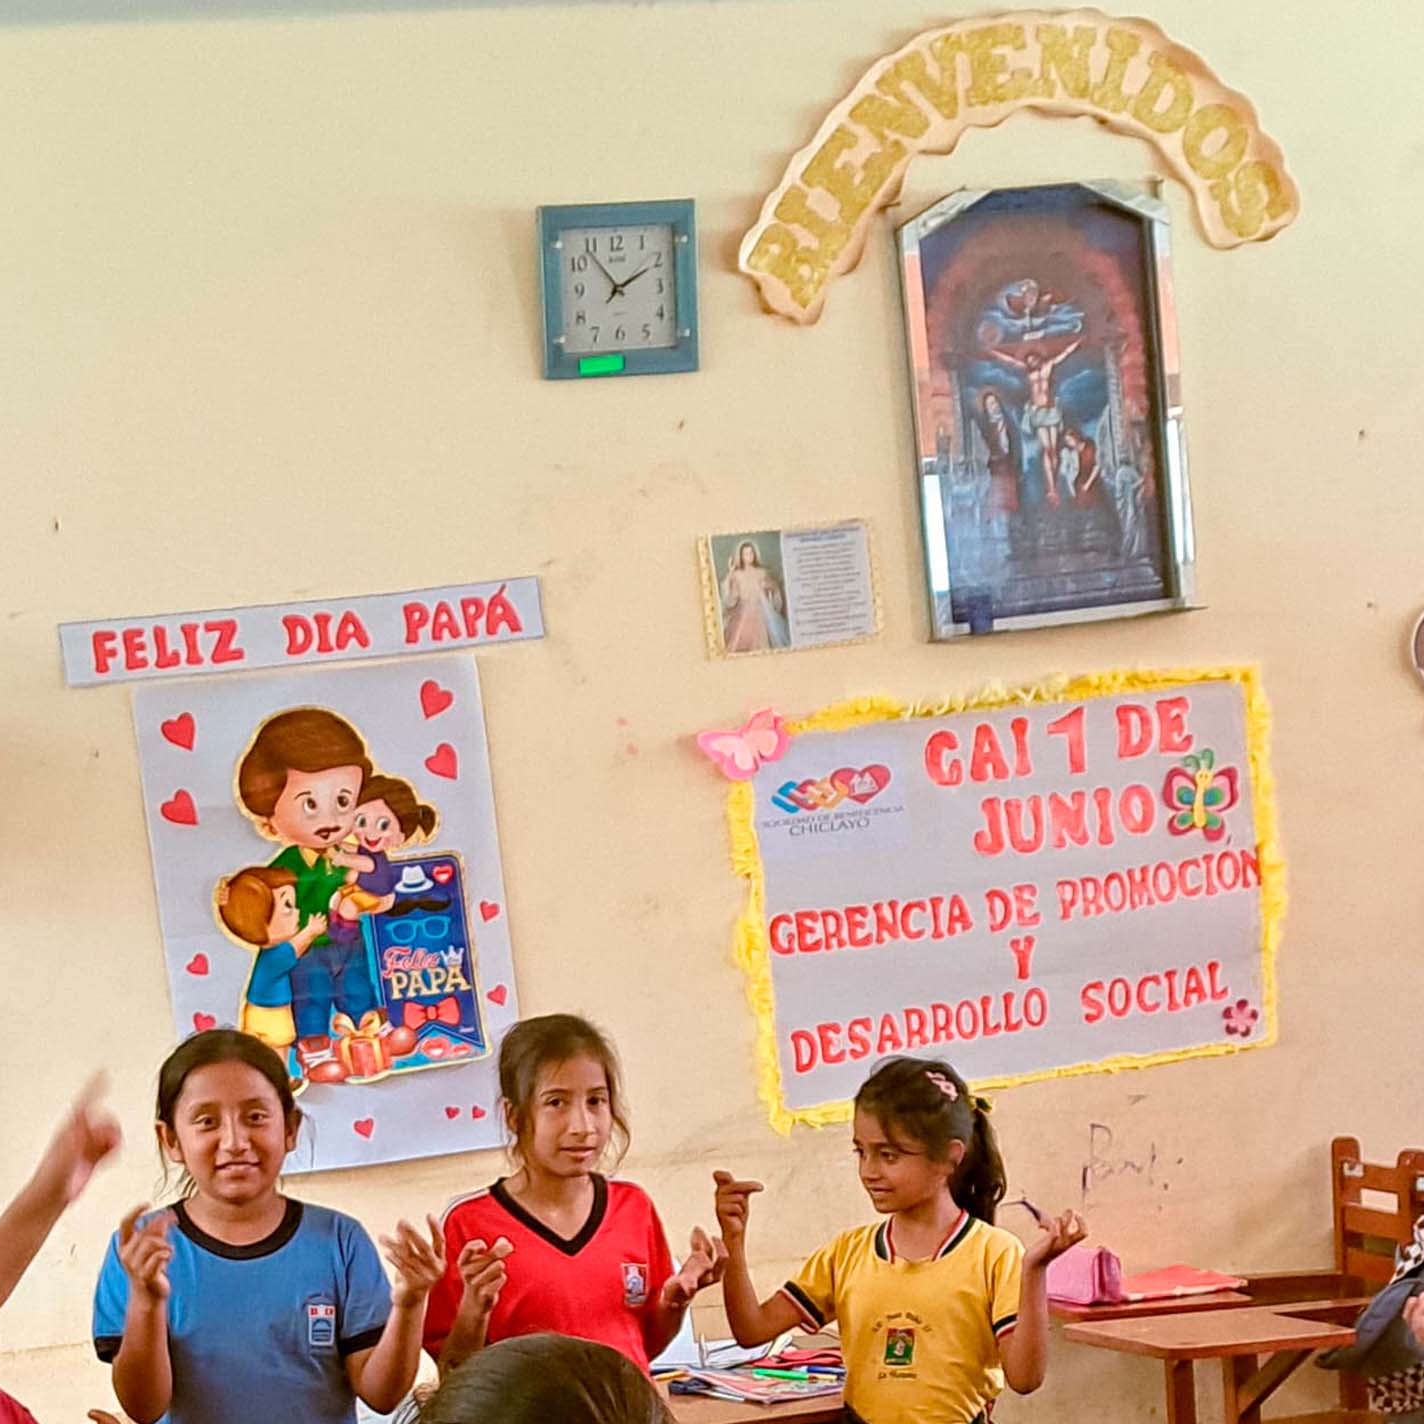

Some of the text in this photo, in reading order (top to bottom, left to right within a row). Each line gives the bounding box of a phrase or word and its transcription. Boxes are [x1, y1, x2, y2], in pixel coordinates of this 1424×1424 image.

[748, 23, 1288, 309] BIENVENIDOS
[585, 237, 597, 253] 11
[610, 235, 624, 251] 12
[571, 255, 588, 273] 10
[574, 283, 585, 298] 9
[590, 326, 600, 342] 7
[616, 324, 625, 340] 6
[641, 323, 651, 339] 5
[92, 584, 523, 673] FELIZ DIA PAPÁ
[1048, 706, 1087, 774] 1
[1116, 696, 1195, 761] DE
[789, 817, 871, 837] CHICLAYO
[974, 783, 1157, 856] JUNIO
[769, 833, 1264, 955] GERENCIA DE PROMOCIÓN
[1009, 935, 1035, 980] Y
[791, 961, 1228, 1073] DESARROLLO SOCIAL
